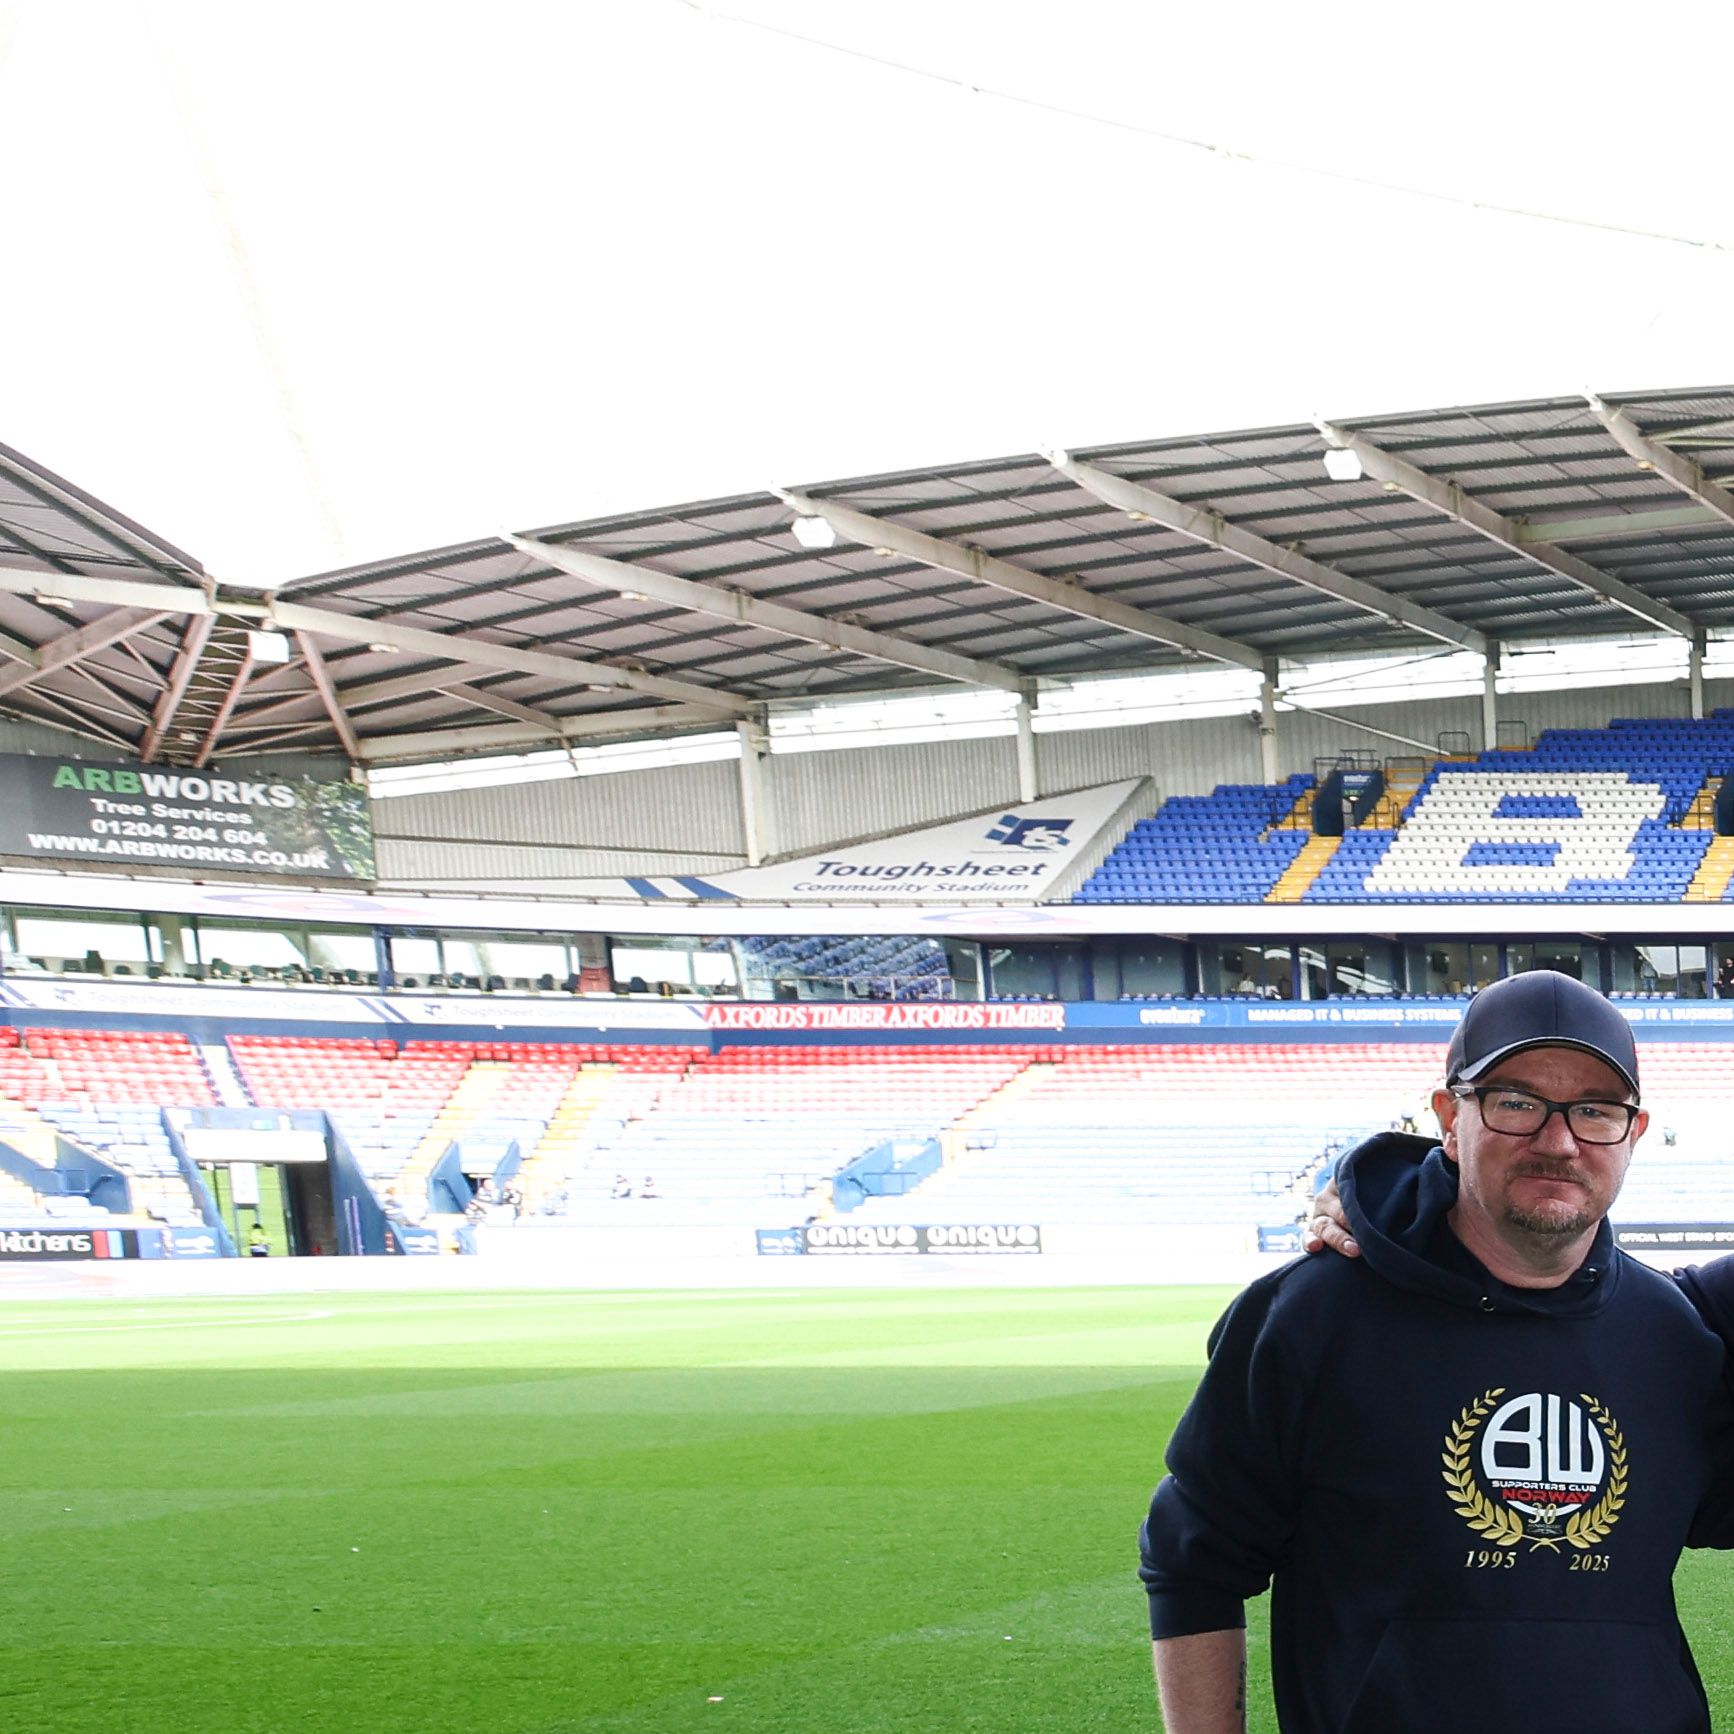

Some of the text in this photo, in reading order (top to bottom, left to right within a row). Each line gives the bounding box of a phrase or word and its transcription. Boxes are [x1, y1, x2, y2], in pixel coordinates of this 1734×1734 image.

[52, 765, 296, 808] ARBWORKS
[90, 798, 252, 825] Tree Services
[89, 818, 268, 846] 01204 204 604
[27, 833, 330, 870] WWW.ARBWORKS.CO.UK
[814, 860, 1048, 880] Toughsheet
[792, 881, 1030, 894] Community Stadium
[709, 1005, 1065, 1028] AXFORDS TIMBER AXFORDS TIMBER
[1248, 1009, 1462, 1020] MANAGED IT & BUSINESS SYSTEMS
[1645, 1009, 1658, 1020] IT
[1660, 1009, 1670, 1020] &
[1672, 1009, 1733, 1020] BUSINESS
[1481, 1393, 1605, 1485] BW
[1491, 1480, 1597, 1493] SUPPORTERS CLUB
[1502, 1487, 1594, 1504] NORWAY
[1527, 1502, 1558, 1525] 30
[1463, 1550, 1610, 1572] 1995 2025
